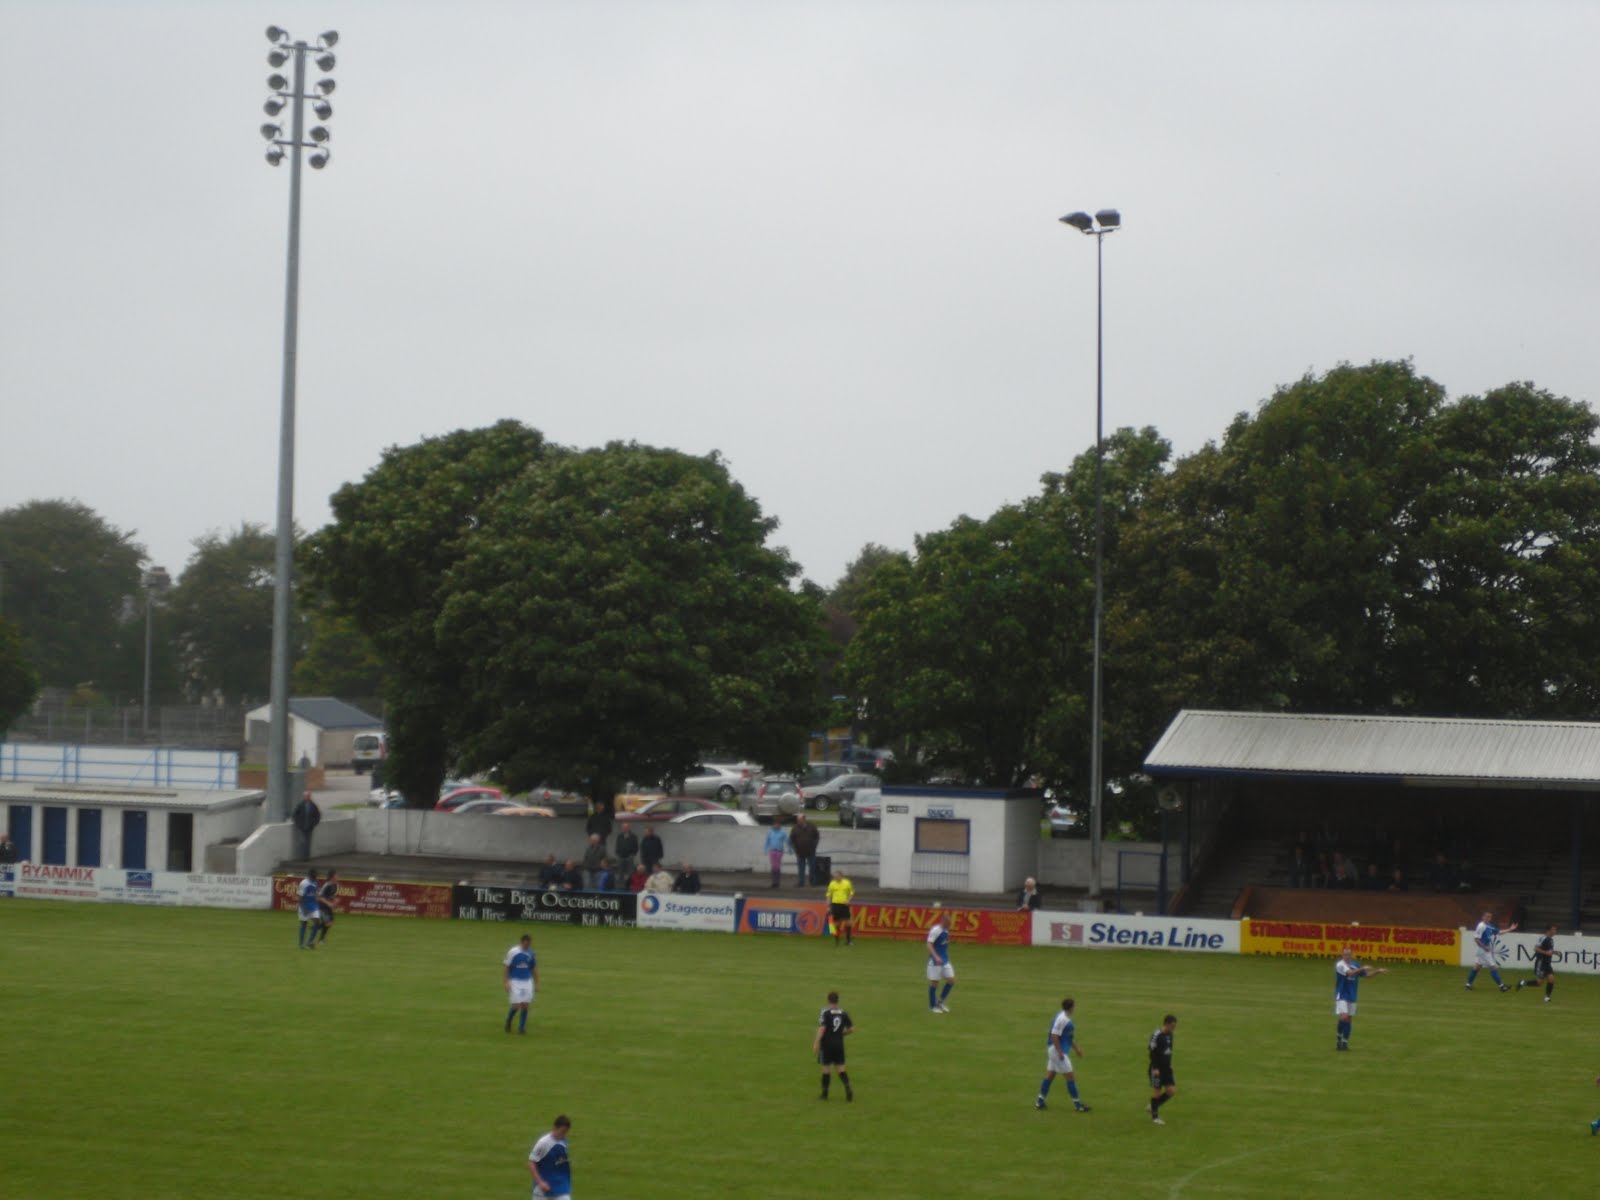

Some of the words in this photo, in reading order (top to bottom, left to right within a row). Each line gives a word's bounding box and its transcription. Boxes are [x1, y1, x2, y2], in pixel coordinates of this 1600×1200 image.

[21, 864, 94, 881] RYANMIX
[474, 888, 505, 904] The
[511, 890, 536, 911] Big
[541, 892, 620, 910] Occasion
[459, 906, 476, 920] Kilt
[482, 908, 506, 921] Hire
[664, 902, 733, 916] Stagecoach
[581, 913, 599, 927] Kilt
[852, 906, 980, 931] McKENZE'S
[1089, 922, 1164, 946] Stena
[1168, 927, 1224, 949] Line
[1325, 925, 1390, 942] RECOVERY
[1393, 928, 1455, 946] SERVICES
[1282, 941, 1309, 952] Class
[1379, 944, 1418, 956] Centre
[833, 1017, 841, 1032] 9
